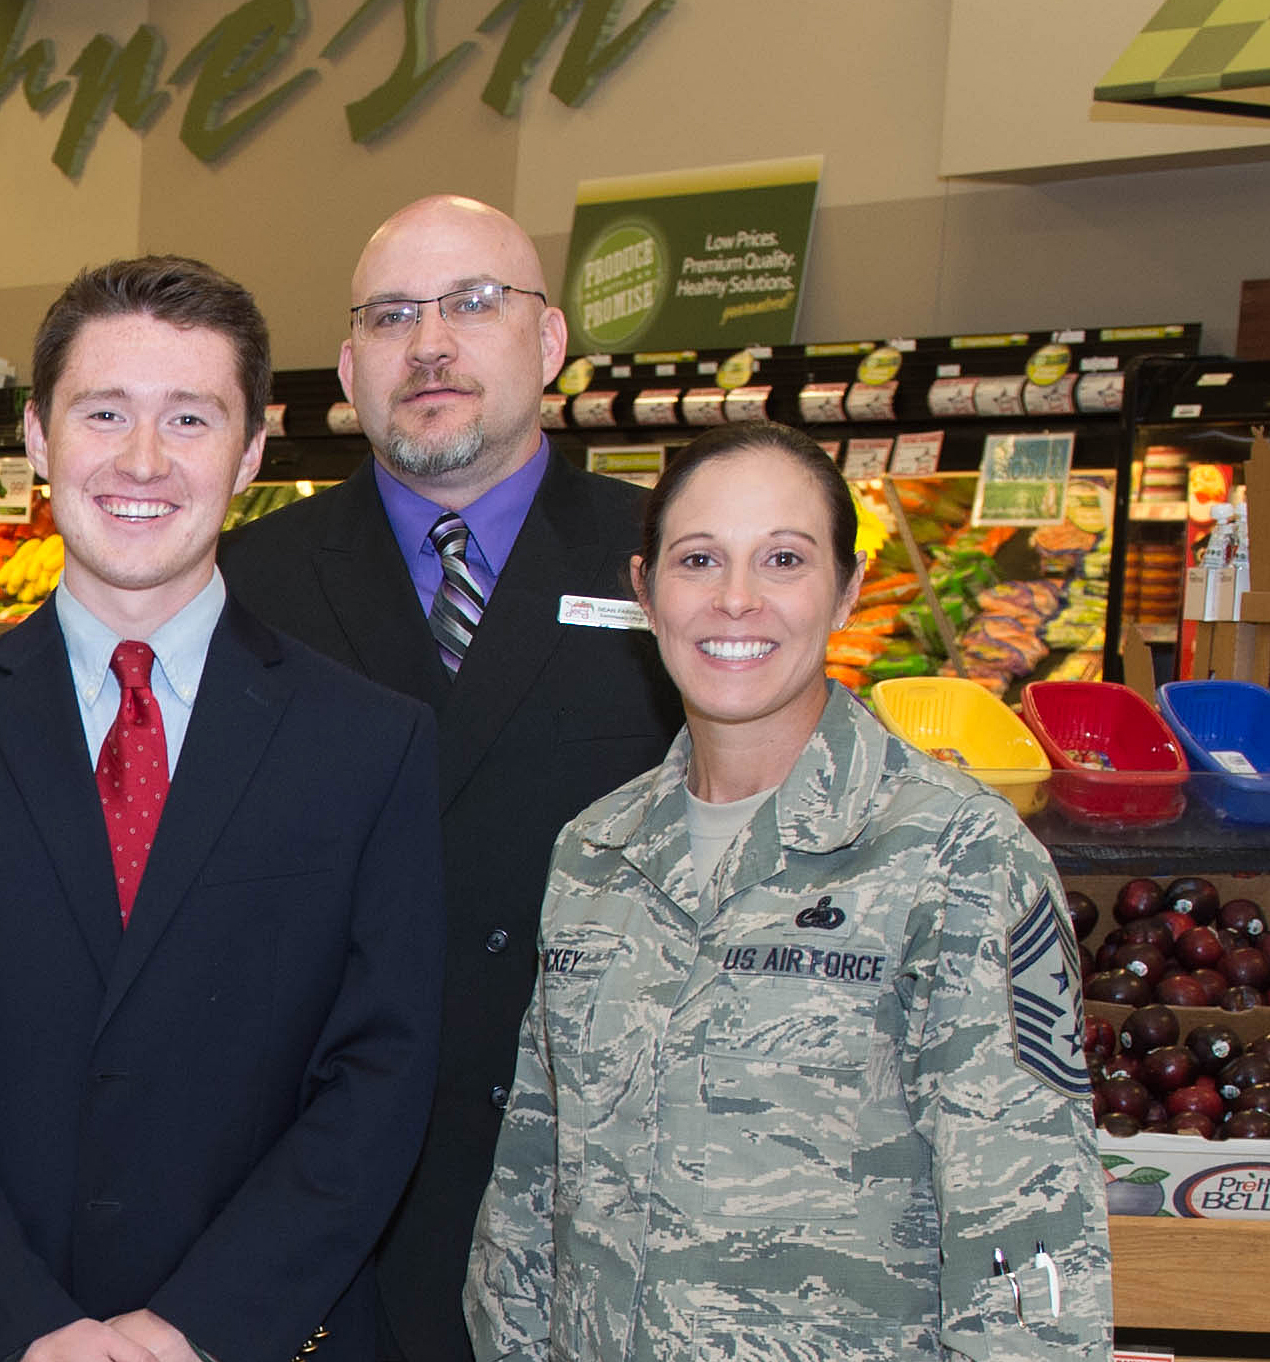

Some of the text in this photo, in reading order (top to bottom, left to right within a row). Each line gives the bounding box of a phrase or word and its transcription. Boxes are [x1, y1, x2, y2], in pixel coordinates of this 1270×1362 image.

[705, 233, 736, 252] Low
[583, 237, 655, 290] PRODUCE
[682, 254, 744, 275] Premium
[675, 276, 727, 299] Healthy
[583, 281, 655, 331] PROMISE
[543, 948, 584, 972] CKEY
[762, 947, 804, 972] AIR
[809, 948, 886, 981] FORCE
